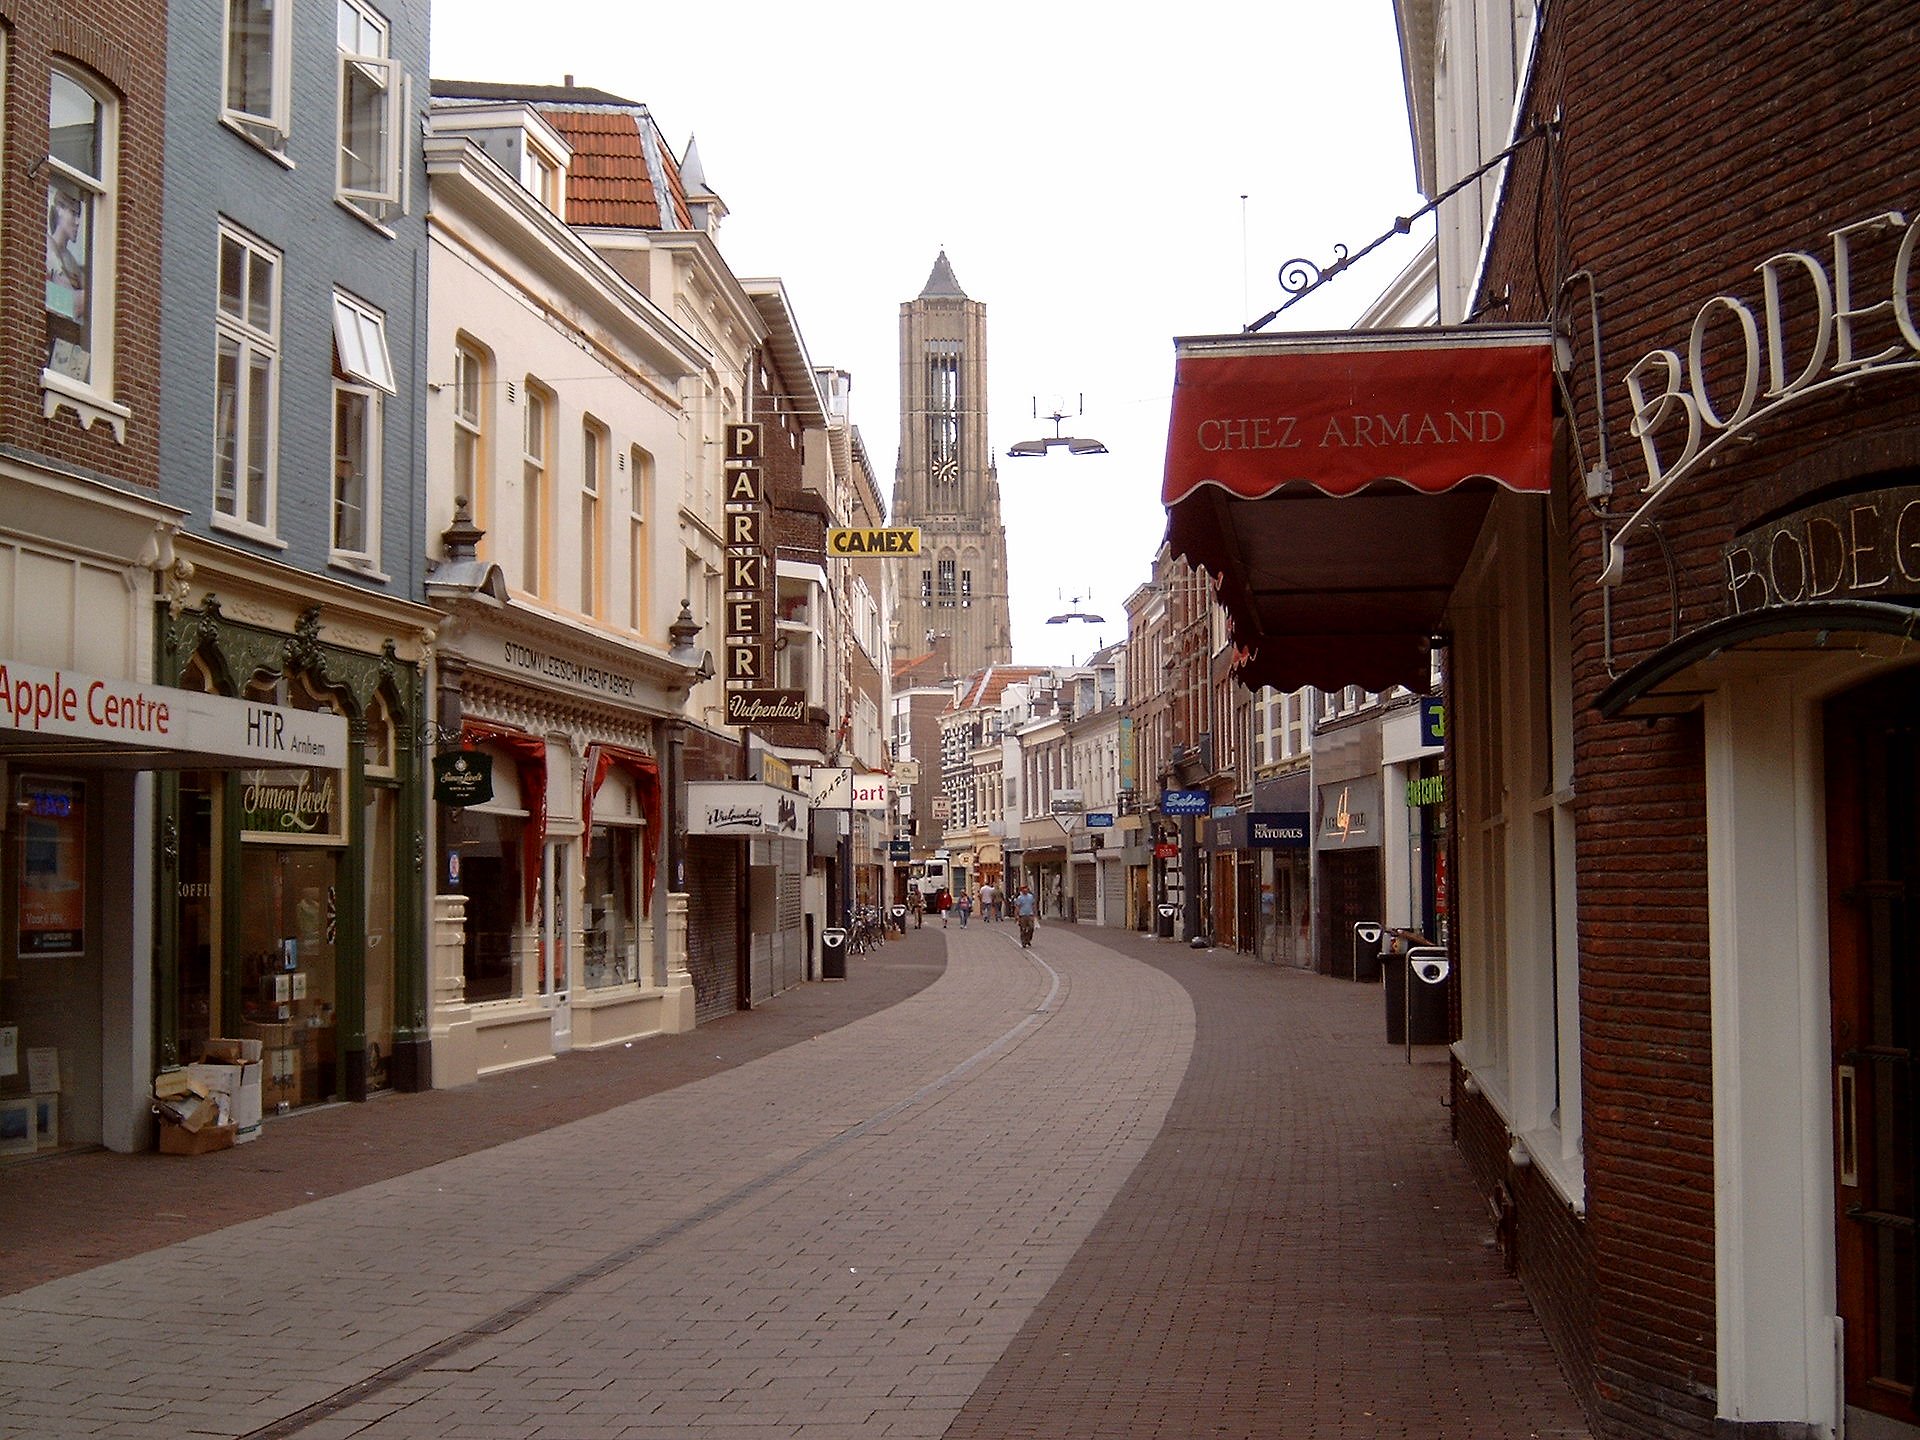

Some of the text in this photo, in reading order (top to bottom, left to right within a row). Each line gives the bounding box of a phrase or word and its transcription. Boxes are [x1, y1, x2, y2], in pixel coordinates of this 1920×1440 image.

[1199, 410, 1506, 452] CHEZ ARMAND
[731, 428, 755, 677] PARKER
[833, 531, 916, 553] CAMEX
[0, 664, 169, 734] Apple Centre
[733, 695, 804, 721] Vulpenhuis
[247, 707, 326, 756] HTR Arnhem
[244, 768, 295, 814] Simon
[1254, 828, 1304, 839] NATURALS
